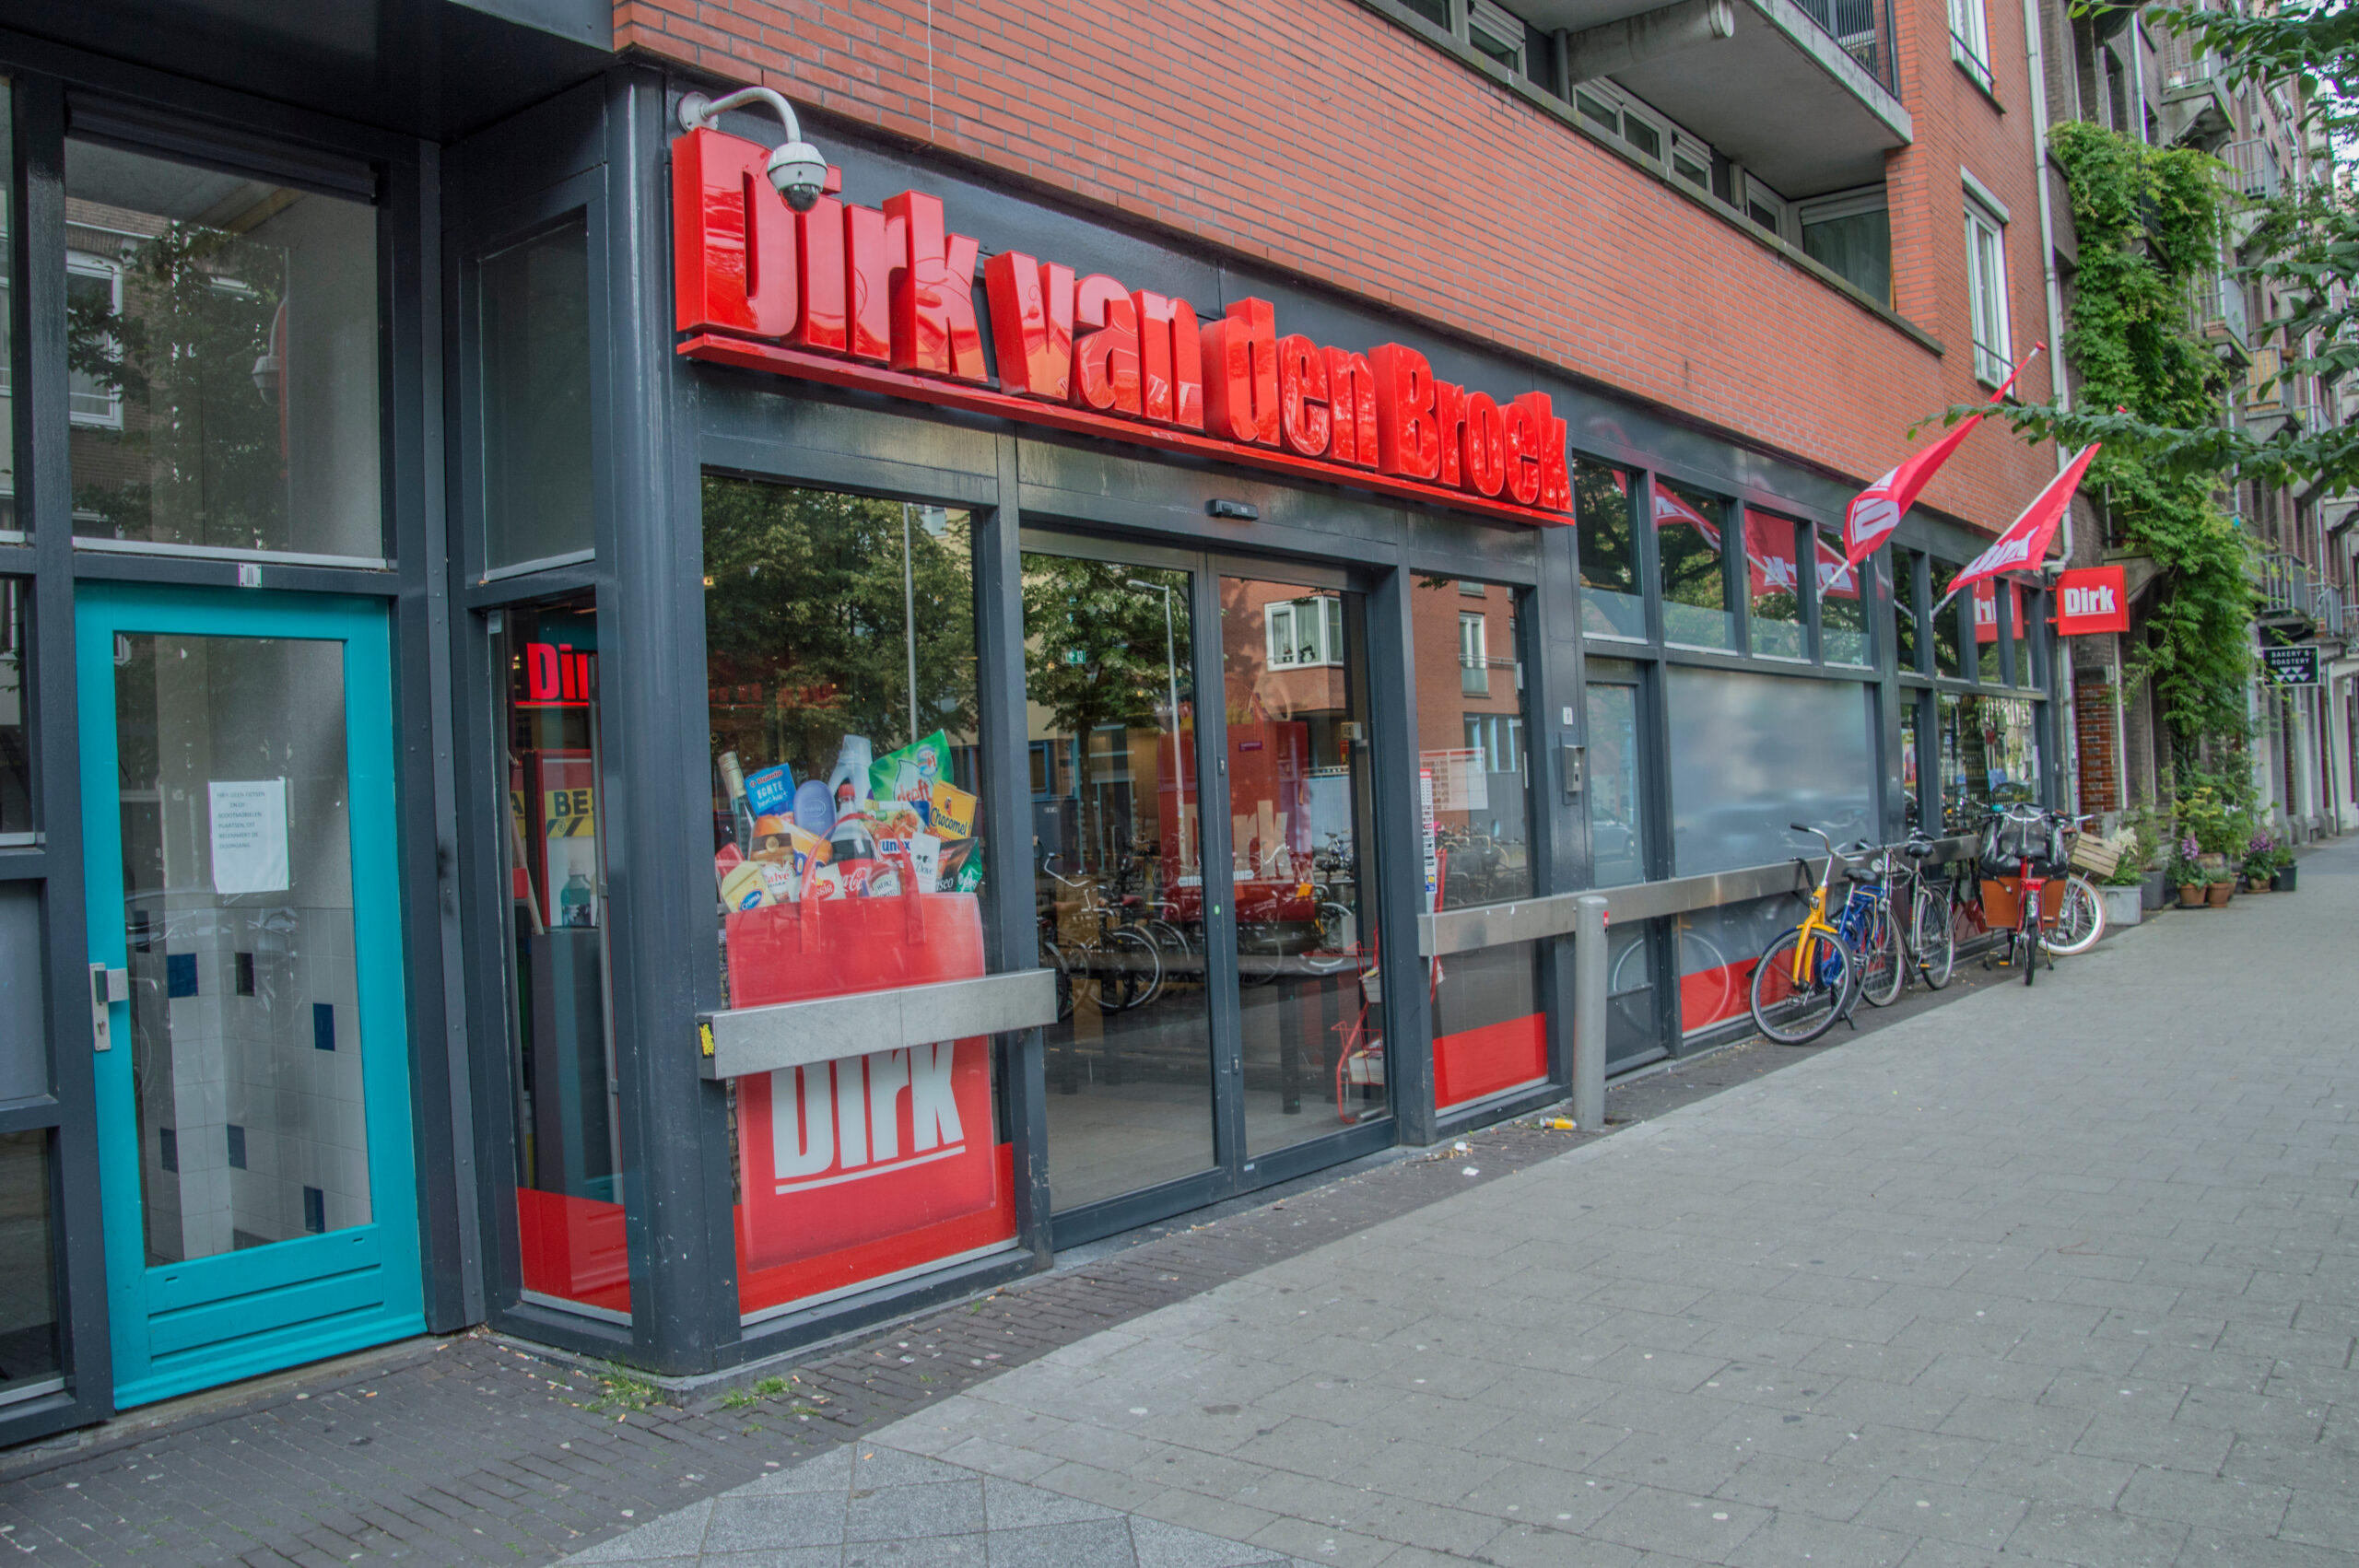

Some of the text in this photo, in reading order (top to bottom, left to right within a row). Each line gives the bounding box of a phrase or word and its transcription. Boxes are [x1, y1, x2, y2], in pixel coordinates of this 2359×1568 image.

[673, 126, 1572, 513] Dirk van den Broek
[2064, 585, 2116, 614] Dirk
[930, 807, 968, 837] Chocomel
[881, 839, 910, 852] unx
[876, 880, 893, 891] HEINZ
[741, 891, 762, 910] Croma
